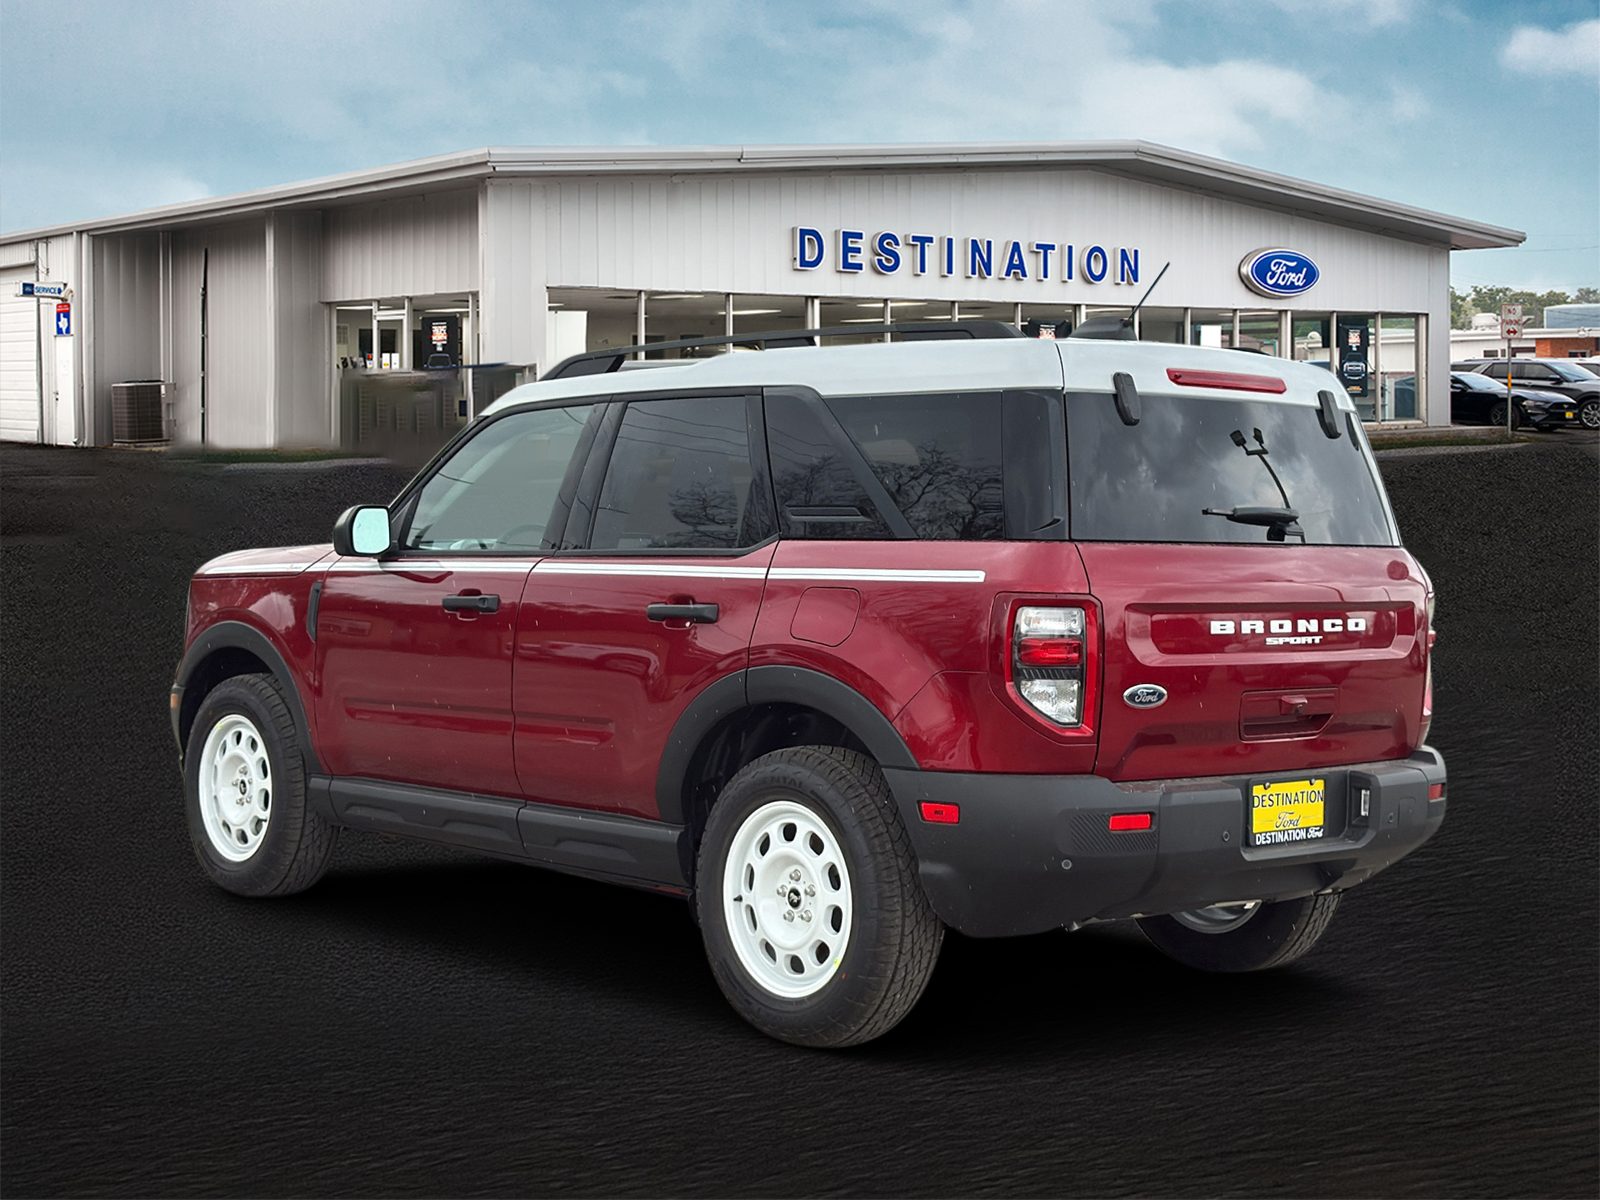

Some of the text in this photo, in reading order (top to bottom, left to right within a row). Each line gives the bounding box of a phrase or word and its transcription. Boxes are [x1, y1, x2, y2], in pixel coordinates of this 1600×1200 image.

[795, 226, 1140, 286] DESTINATION
[1266, 258, 1307, 287] Ford
[35, 286, 57, 295] SERVICE
[1210, 618, 1367, 635] BRONCO
[1265, 635, 1323, 646] SPORT
[1134, 688, 1159, 703] Ford
[1252, 789, 1324, 809] DESTINATION
[1275, 810, 1301, 829] Ford
[1255, 826, 1324, 846] DESTINATION Ford
